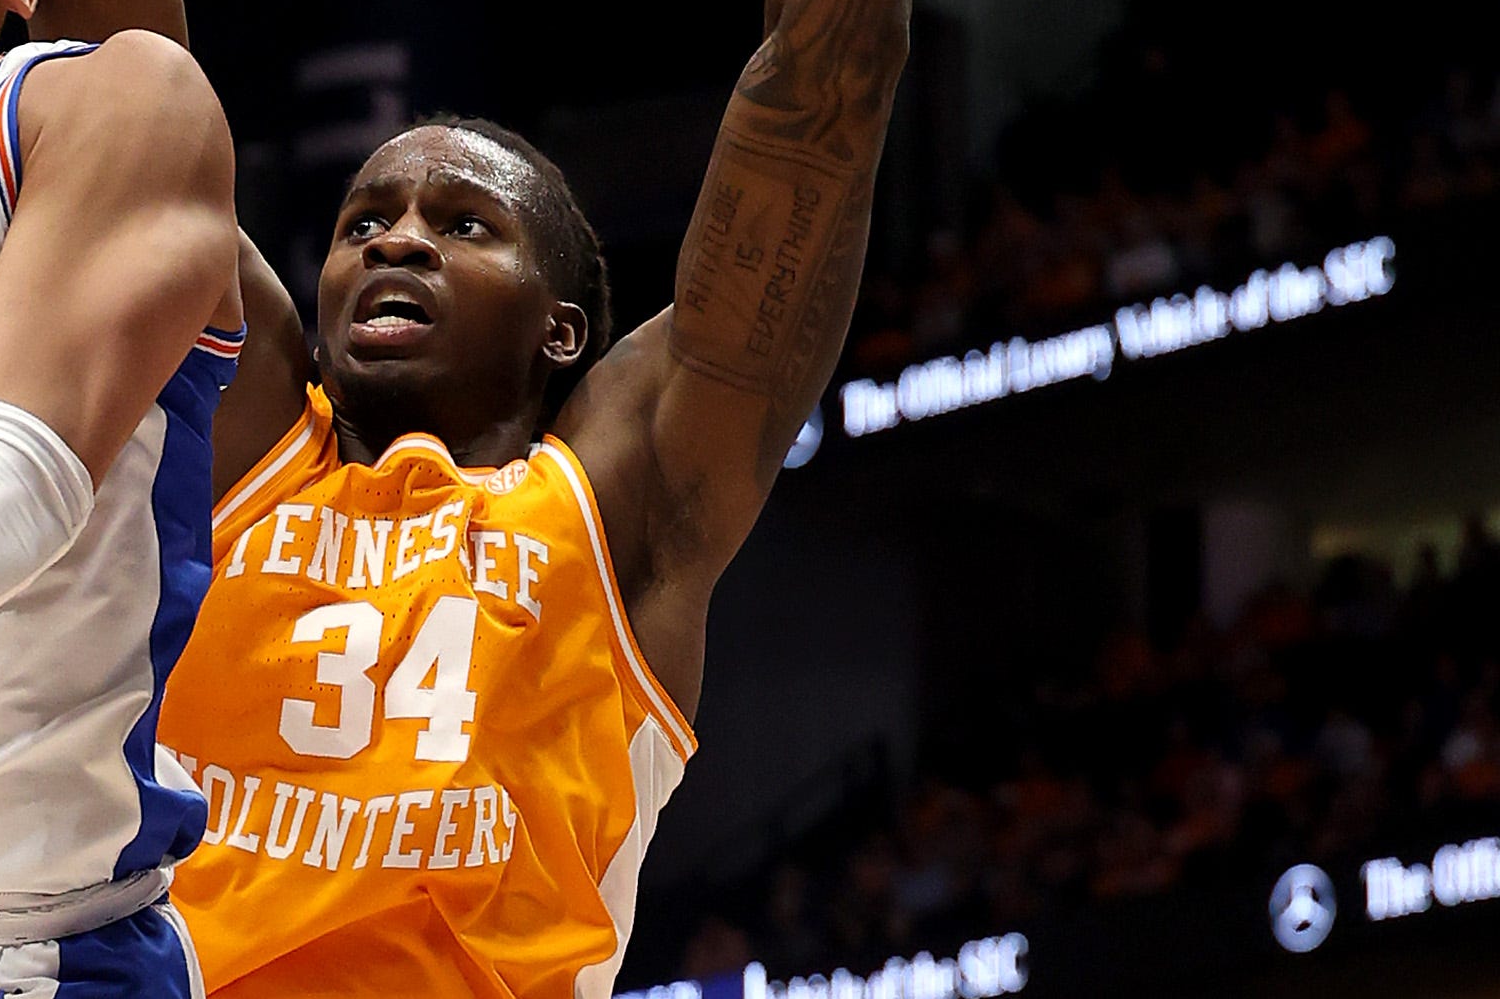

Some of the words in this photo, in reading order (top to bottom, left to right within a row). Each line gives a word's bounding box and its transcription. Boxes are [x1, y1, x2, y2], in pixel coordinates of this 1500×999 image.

[734, 242, 765, 273] IS
[748, 184, 821, 357] EVERYTHING
[488, 463, 526, 492] SEC
[225, 499, 548, 624] TENNESEE
[278, 594, 479, 763] 34
